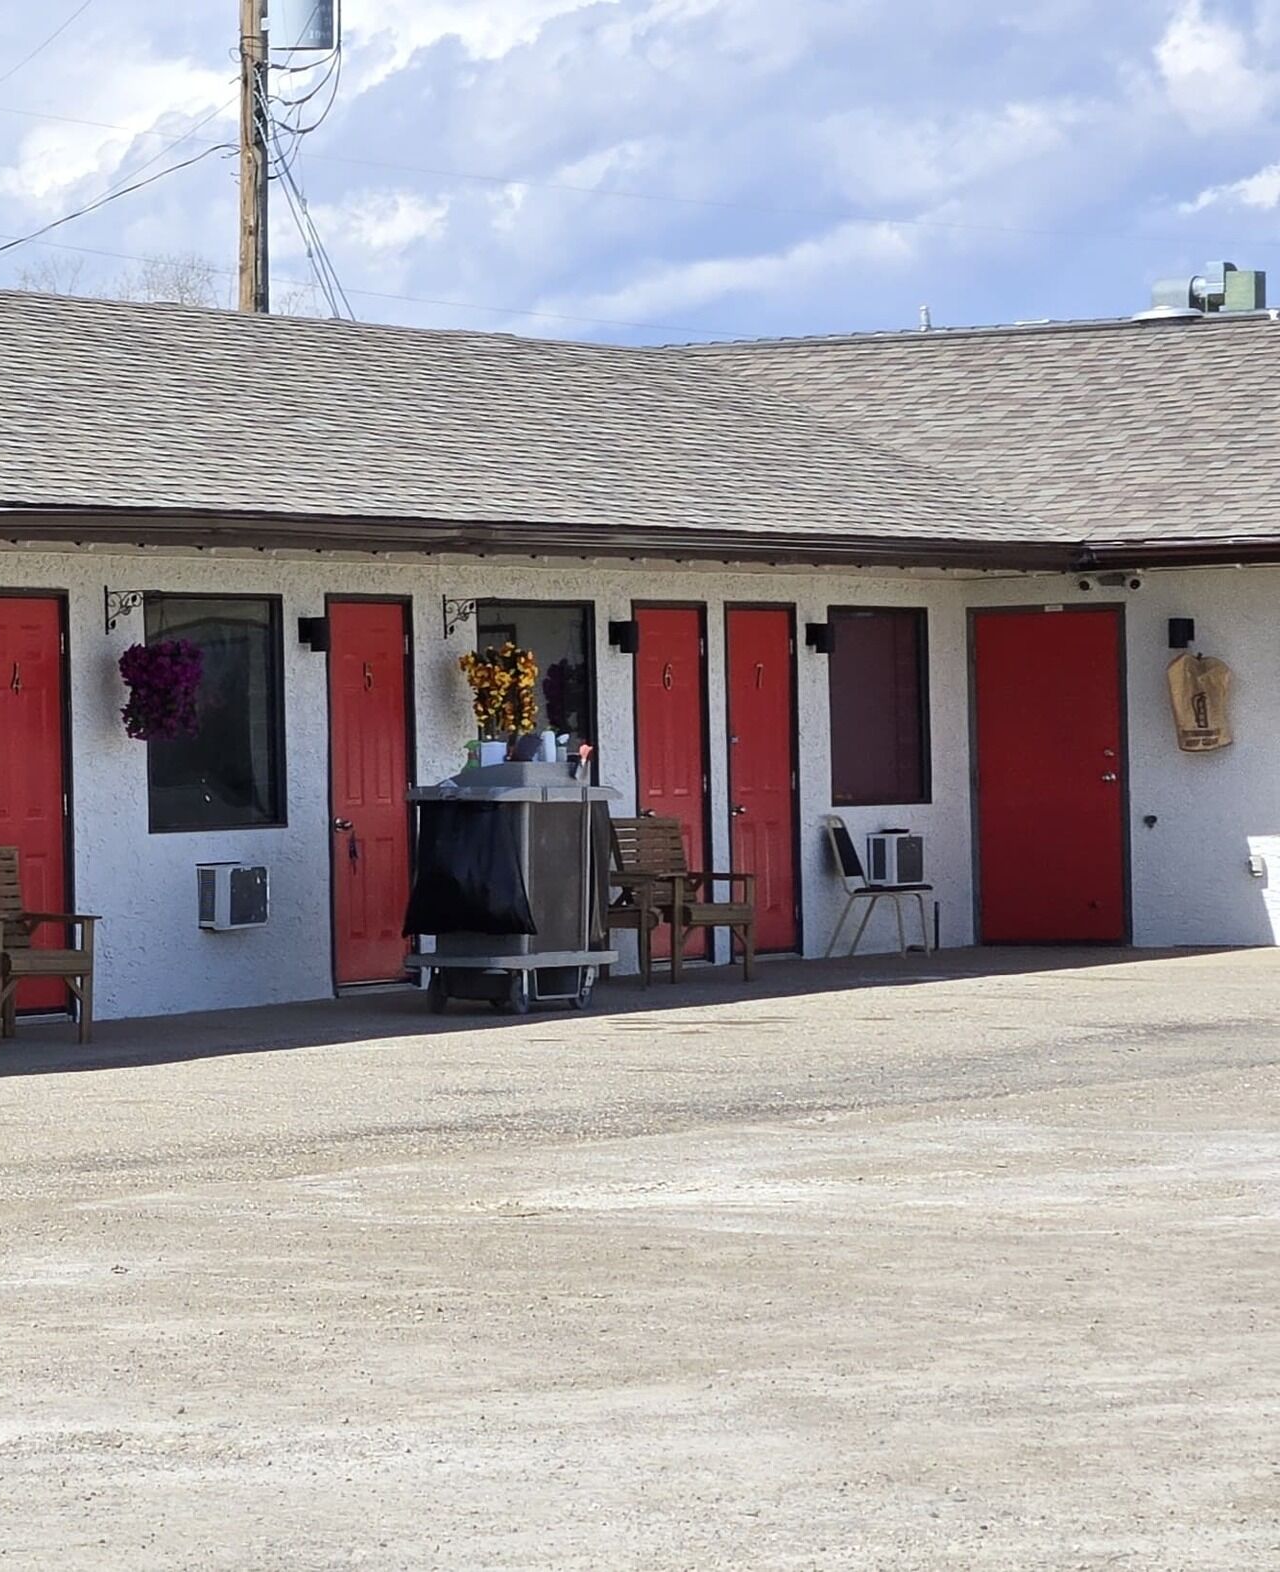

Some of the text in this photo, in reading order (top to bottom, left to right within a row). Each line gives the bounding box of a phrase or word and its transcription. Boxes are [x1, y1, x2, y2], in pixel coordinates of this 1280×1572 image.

[11, 661, 22, 696] 4
[363, 661, 374, 692] 5
[662, 662, 672, 691] 6
[754, 662, 764, 689] 7
